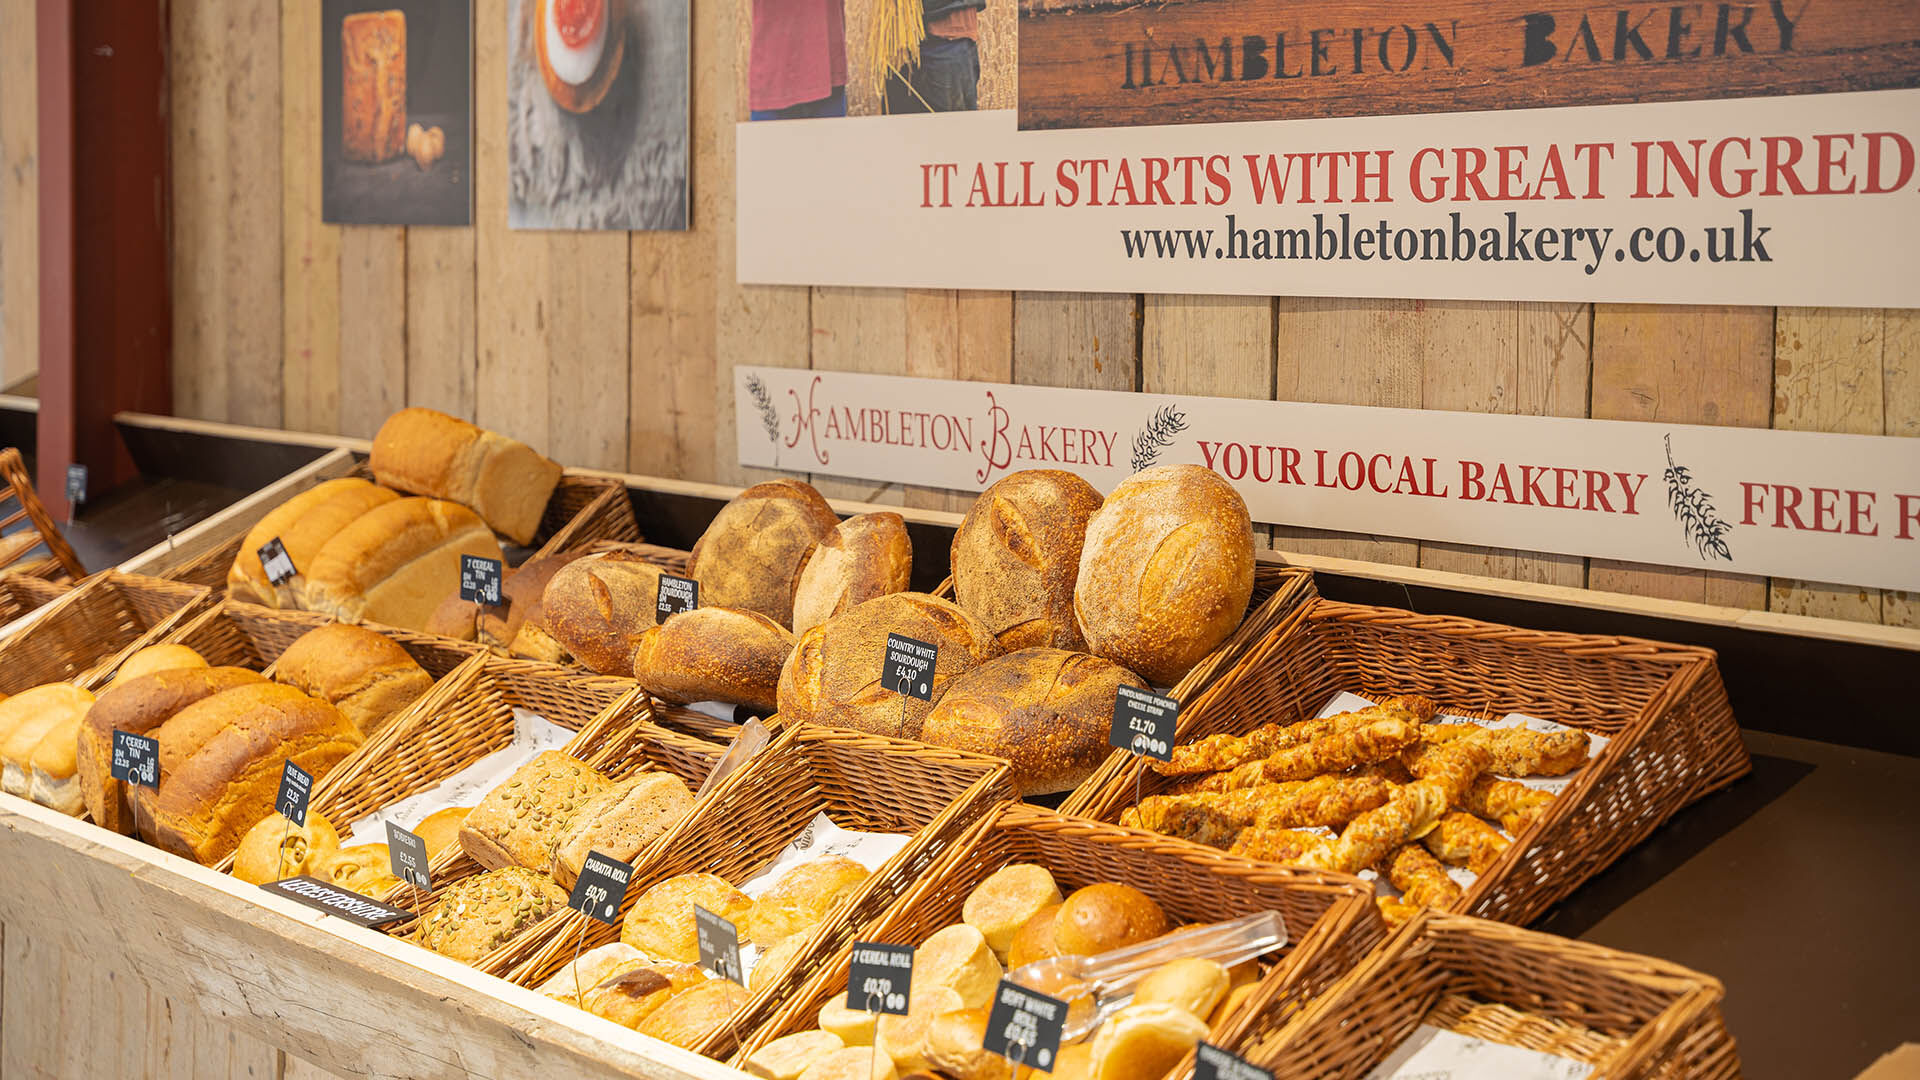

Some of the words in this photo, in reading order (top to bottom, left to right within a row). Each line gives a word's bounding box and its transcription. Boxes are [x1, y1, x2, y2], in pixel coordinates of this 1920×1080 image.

[1120, 19, 1459, 90] HAMBLETON
[1522, 0, 1806, 67] BAKERY
[920, 163, 958, 208] IT
[965, 161, 1045, 207] ALL
[1055, 154, 1232, 207] STARTS
[1242, 150, 1395, 205] WITH
[1408, 143, 1615, 203] GREAT
[1629, 131, 1920, 198] INGRED
[1120, 208, 1773, 275] www.hambletonbakery.co.uk
[784, 375, 973, 465] HAMBLETON
[976, 391, 1118, 484] BAKERY
[1196, 440, 1306, 486] YOUR
[1314, 449, 1448, 498] LOCAL
[1458, 460, 1649, 515] BAKERY
[1739, 482, 1879, 537] FREE
[660, 585, 693, 601] SOURDOUGH
[661, 577, 693, 592] HAMBLETON
[887, 637, 915, 654] COUNTRY
[915, 645, 936, 660] WHITE
[890, 651, 929, 672] SOURDOUGH
[895, 665, 917, 681] £4.10
[1128, 716, 1156, 735] £1.70
[120, 735, 126, 745] 7
[126, 736, 151, 752] CEREAL
[129, 747, 141, 759] TIN
[585, 857, 613, 878] CIABATTA
[611, 867, 628, 885] ROLL
[278, 879, 397, 921] LEICESTERSHIRE
[585, 884, 608, 902] £0.70
[860, 949, 889, 966] CEREAL
[889, 952, 912, 969] ROLL
[1001, 987, 1027, 1008] SOFT
[1024, 996, 1058, 1021] WHITE
